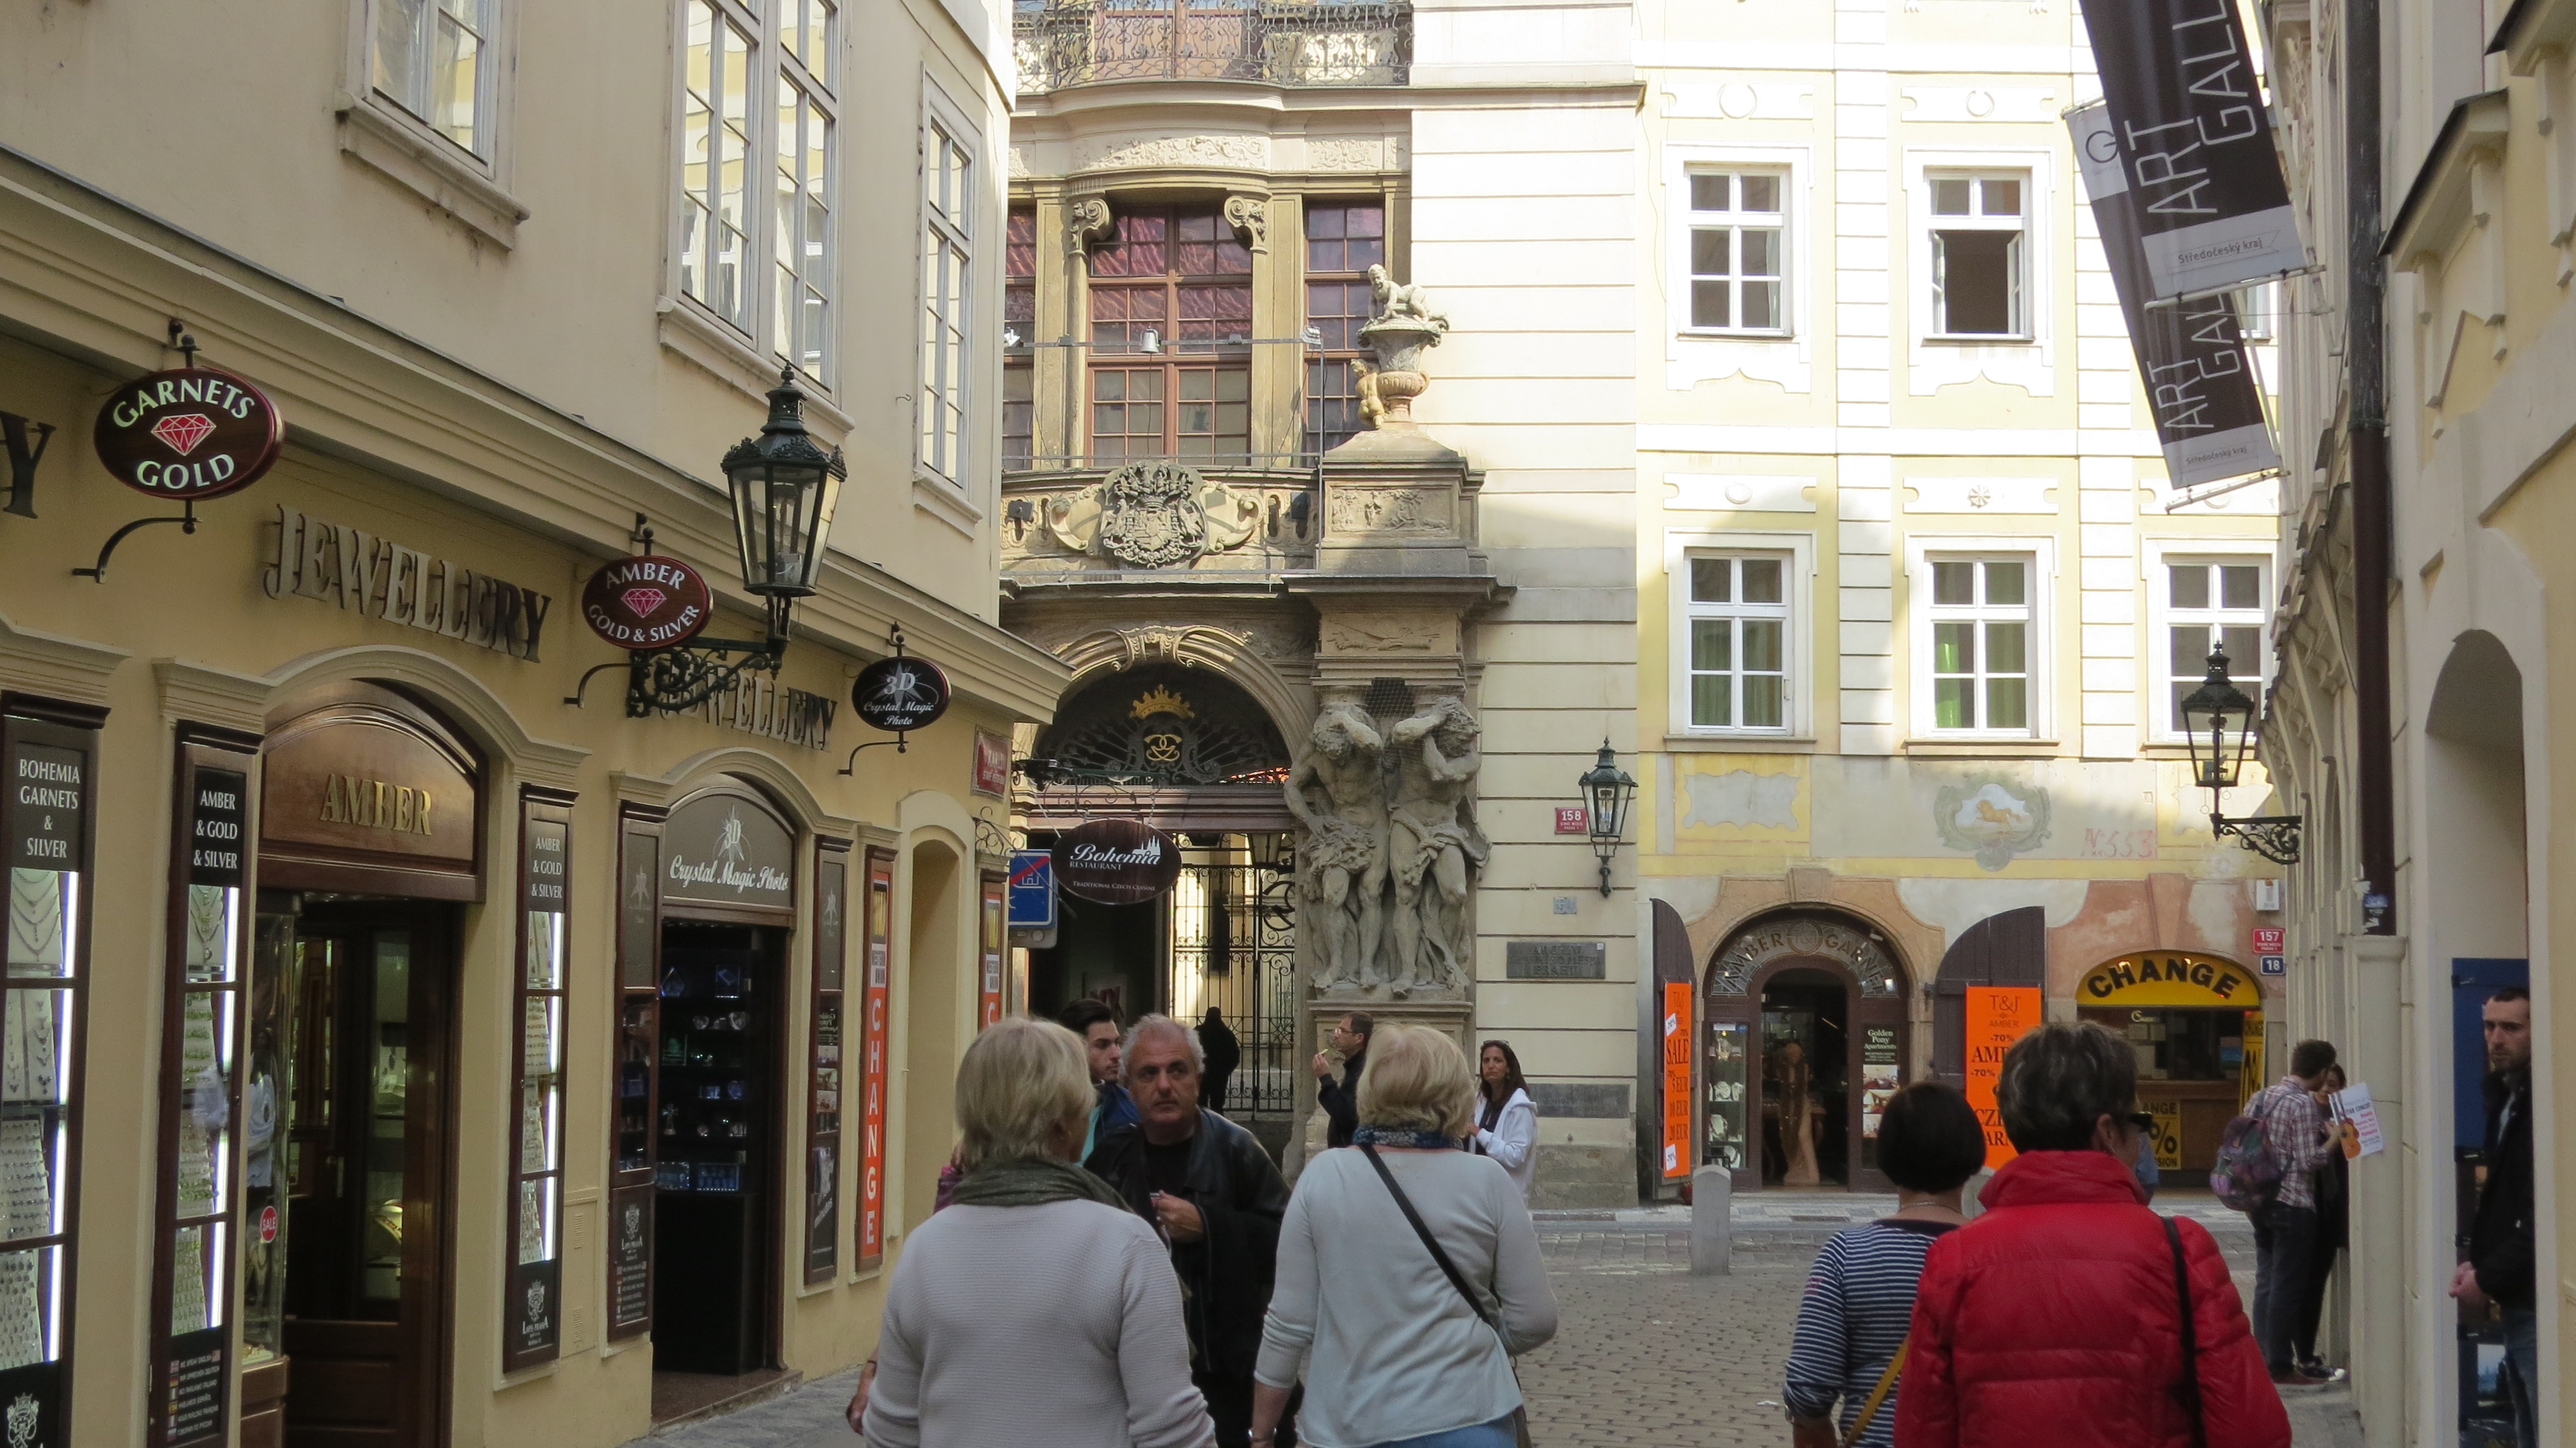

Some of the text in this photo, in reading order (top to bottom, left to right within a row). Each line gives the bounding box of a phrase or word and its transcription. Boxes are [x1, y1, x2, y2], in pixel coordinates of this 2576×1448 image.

[2172, 0, 2257, 146] GALL
[2123, 120, 2218, 214] ART
[2177, 237, 2263, 263] Středočeský kraj
[113, 378, 255, 428] GARNETS
[2146, 359, 2215, 428] ART
[2186, 445, 2247, 465] Středočeský kraj
[136, 453, 235, 490] GOLD
[263, 503, 553, 665] JEWELLERY
[606, 562, 686, 590] AMBER
[588, 604, 700, 642] GOLD & SILVER
[883, 672, 916, 695] 3D
[864, 701, 934, 714] Crystal Magic
[884, 715, 913, 725] Photo
[19, 759, 80, 785] BOHEMIA
[20, 785, 79, 810] GARNETS
[200, 790, 236, 811] AMBER
[319, 773, 433, 835] AMBER
[44, 815, 53, 830] &
[1562, 810, 1582, 821] 158
[196, 819, 238, 840] & GOLD
[724, 819, 742, 850] 3D
[26, 837, 67, 859] SILVER
[535, 837, 560, 852] AMBER
[1070, 843, 1160, 865] Bohemia
[193, 850, 238, 870] & SILVER
[533, 859, 562, 875] & GOLD
[1070, 861, 1122, 870] RESTAURANT
[669, 855, 789, 894] Crystal Magic Photo
[531, 883, 562, 899] & SILVER
[2259, 931, 2280, 942] 157
[2266, 960, 2280, 971] 18
[2087, 958, 2242, 1000] CHANGE
[1989, 1020, 2019, 1028] AMBER
[1990, 1034, 2015, 1042] -70%
[1667, 1038, 1689, 1065] SALE
[1971, 1069, 1995, 1077] -70%
[1676, 1076, 1689, 1093] EUR
[1676, 1100, 1689, 1117] EUR
[2143, 1102, 2177, 1114] ANGE
[866, 998, 882, 1244] CHANGE
[1676, 1123, 1689, 1140] EUR
[262, 1216, 276, 1232] SALE
